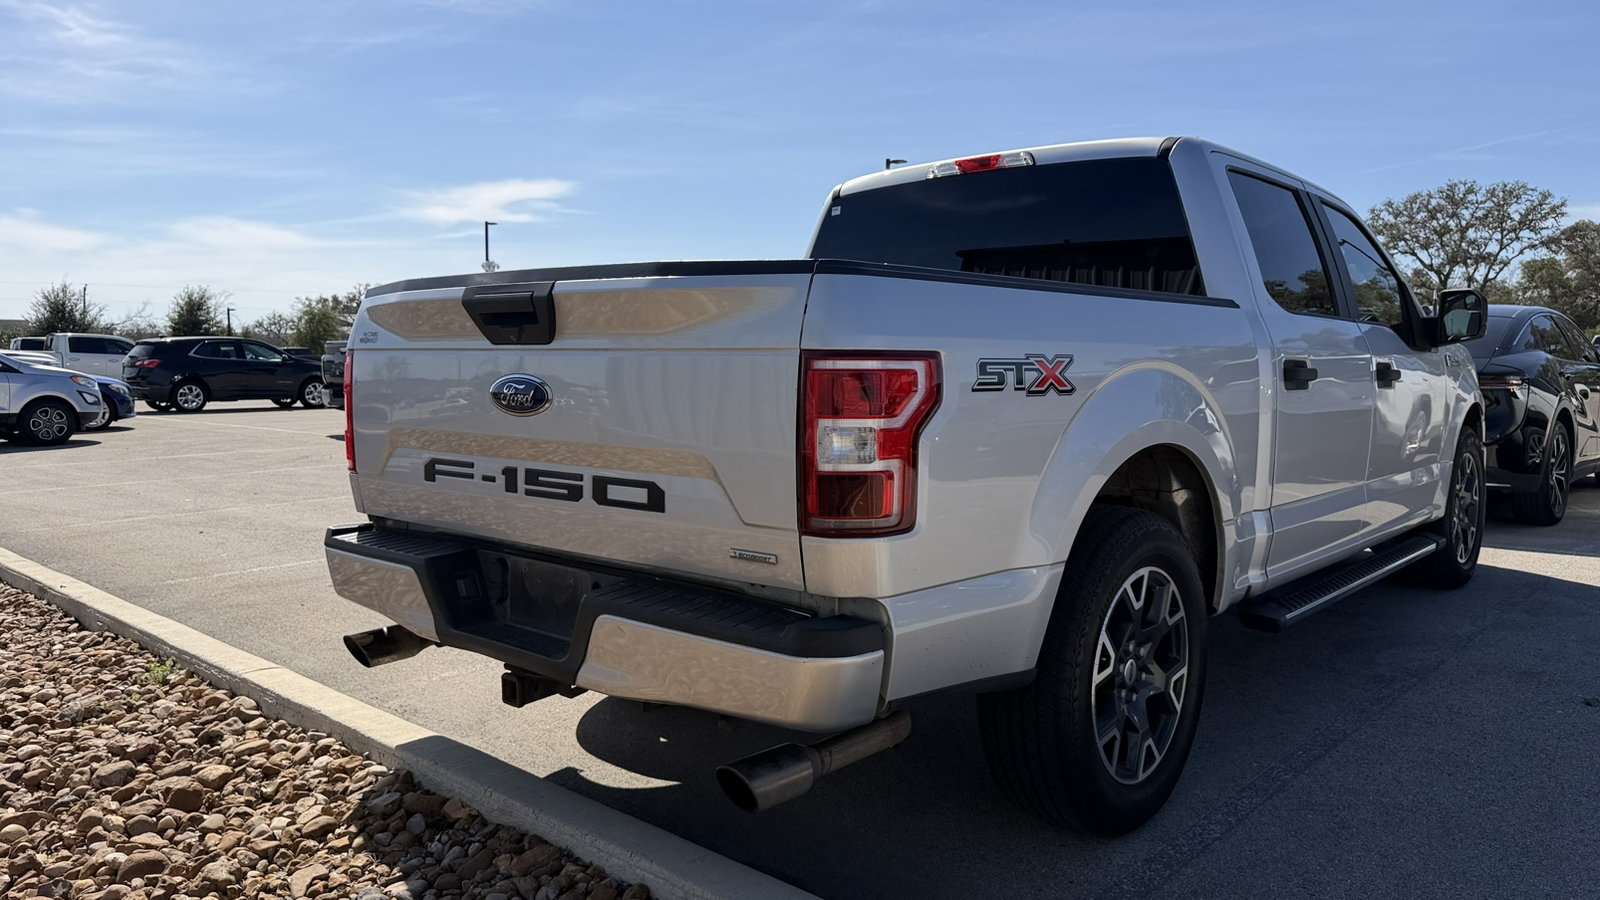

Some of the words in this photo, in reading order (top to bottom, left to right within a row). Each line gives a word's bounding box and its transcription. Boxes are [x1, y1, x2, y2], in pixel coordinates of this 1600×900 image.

[501, 383, 534, 406] Ford
[971, 354, 1077, 397] STX
[424, 457, 665, 513] F-150
